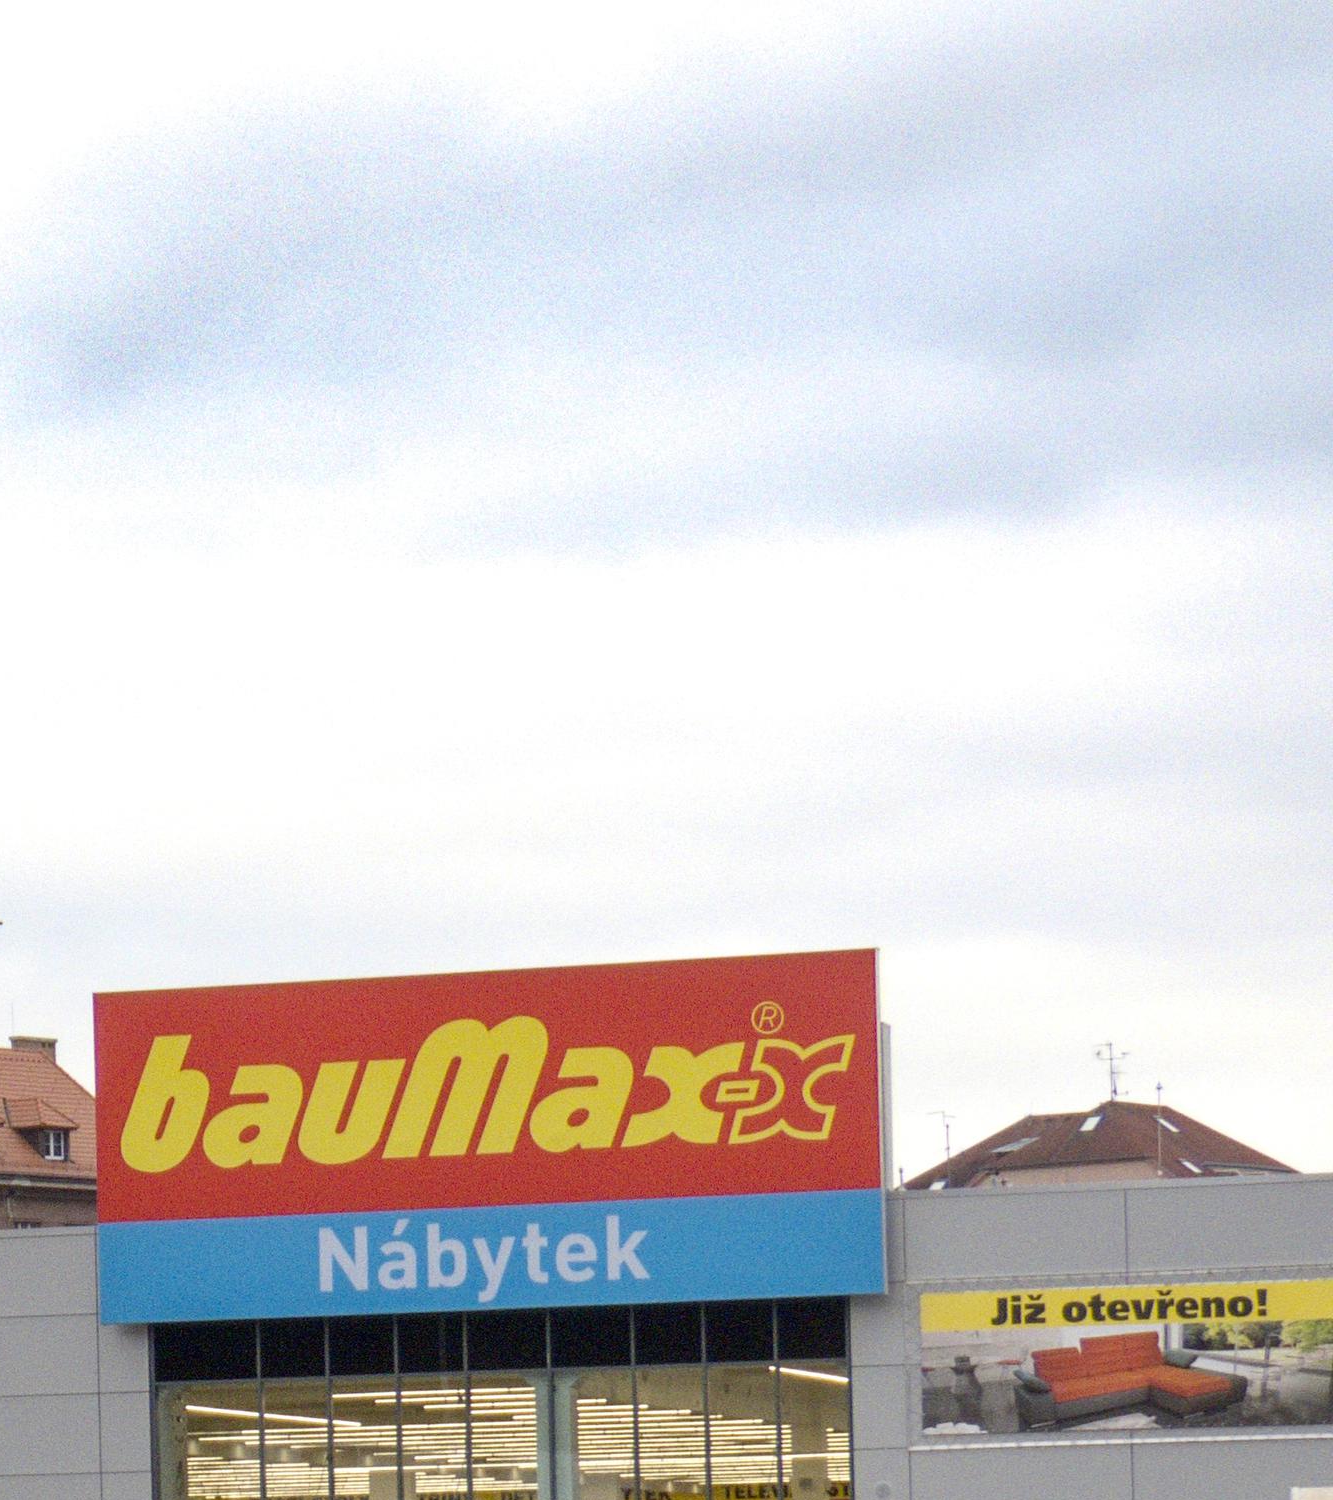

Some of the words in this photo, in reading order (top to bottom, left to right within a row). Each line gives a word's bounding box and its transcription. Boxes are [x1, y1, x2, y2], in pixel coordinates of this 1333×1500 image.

[318, 1214, 651, 1302] Nábytek
[991, 1294, 1046, 1325] Již
[1062, 1289, 1267, 1322] otevřeno!
